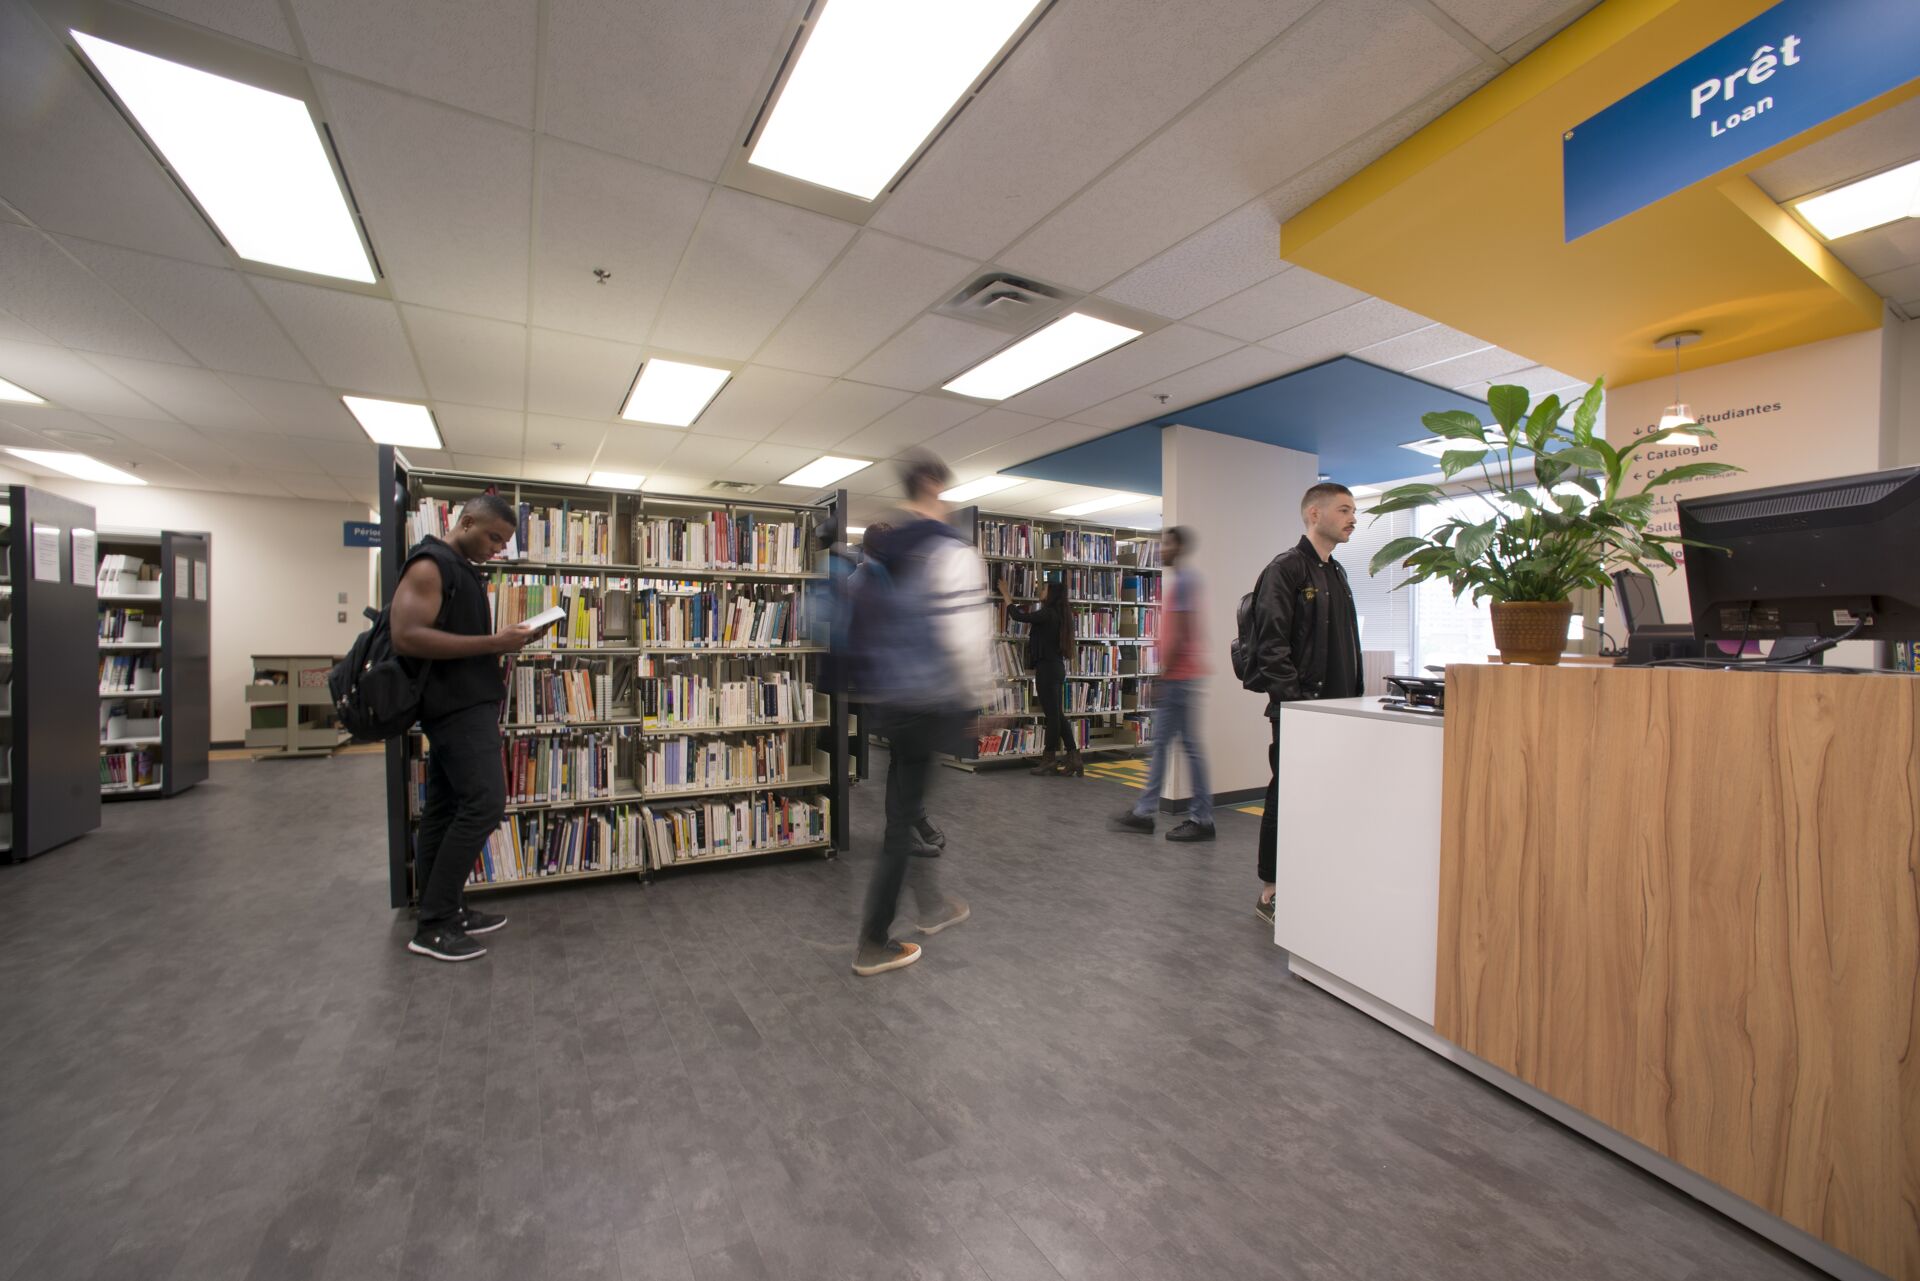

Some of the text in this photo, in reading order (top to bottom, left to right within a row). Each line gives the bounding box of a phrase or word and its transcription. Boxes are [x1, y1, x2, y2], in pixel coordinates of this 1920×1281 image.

[1691, 35, 1800, 119] Prêt
[1711, 97, 1773, 138] Loan
[1697, 402, 1781, 425] étudiantes
[1647, 443, 1719, 461] Catalogue
